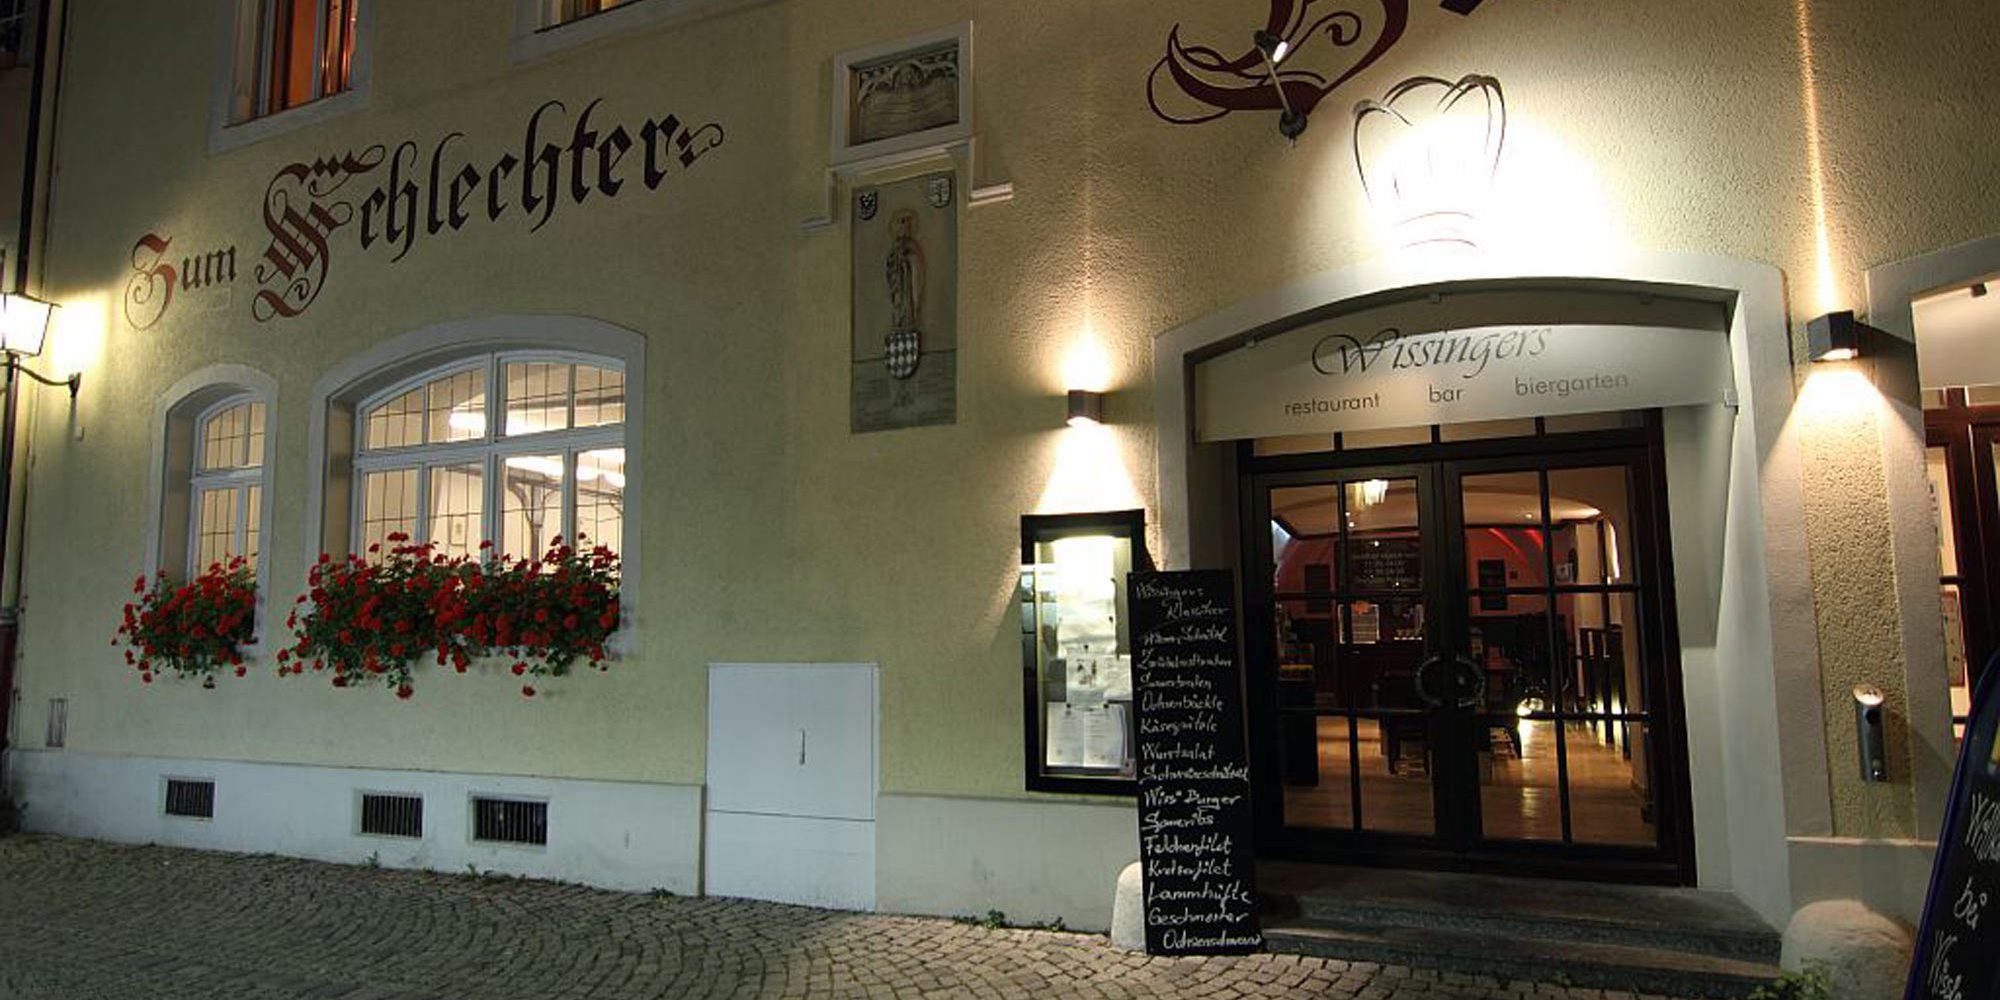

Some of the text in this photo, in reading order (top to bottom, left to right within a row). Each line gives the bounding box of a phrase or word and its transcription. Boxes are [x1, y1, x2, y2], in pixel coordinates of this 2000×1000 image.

[124, 98, 688, 331] Zum Schlechter
[1312, 326, 1552, 378] Wissingers
[1284, 372, 1629, 417] restaurant bar biergarten
[1148, 880, 1253, 908] Lammhüfte
